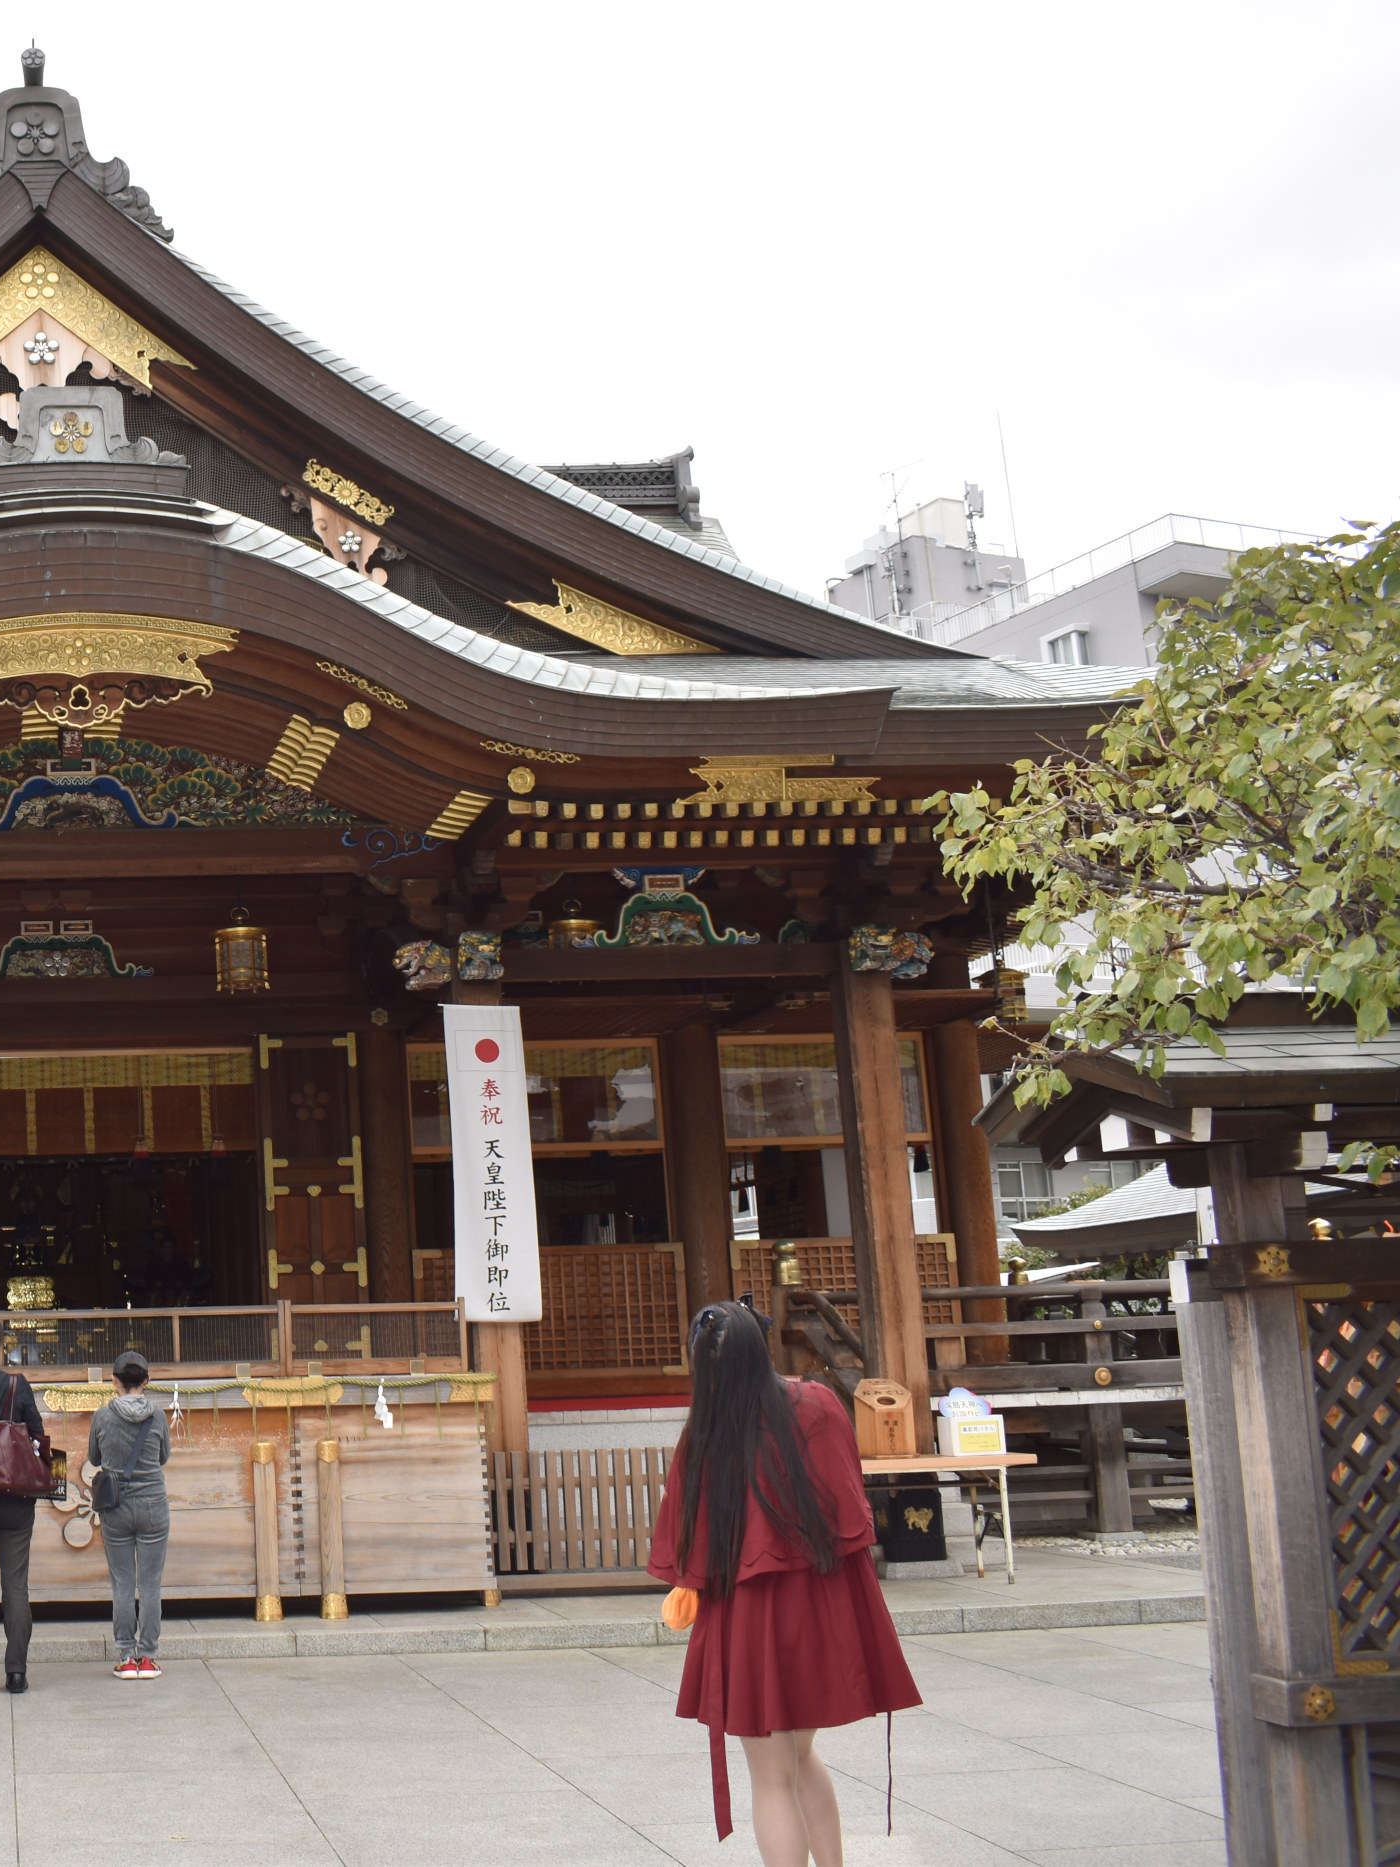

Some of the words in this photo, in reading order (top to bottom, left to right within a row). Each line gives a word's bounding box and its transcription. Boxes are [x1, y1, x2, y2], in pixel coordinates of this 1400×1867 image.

[479, 1078, 503, 1126] 奉祝
[483, 1139, 511, 1313] 天皇陛下御即位
